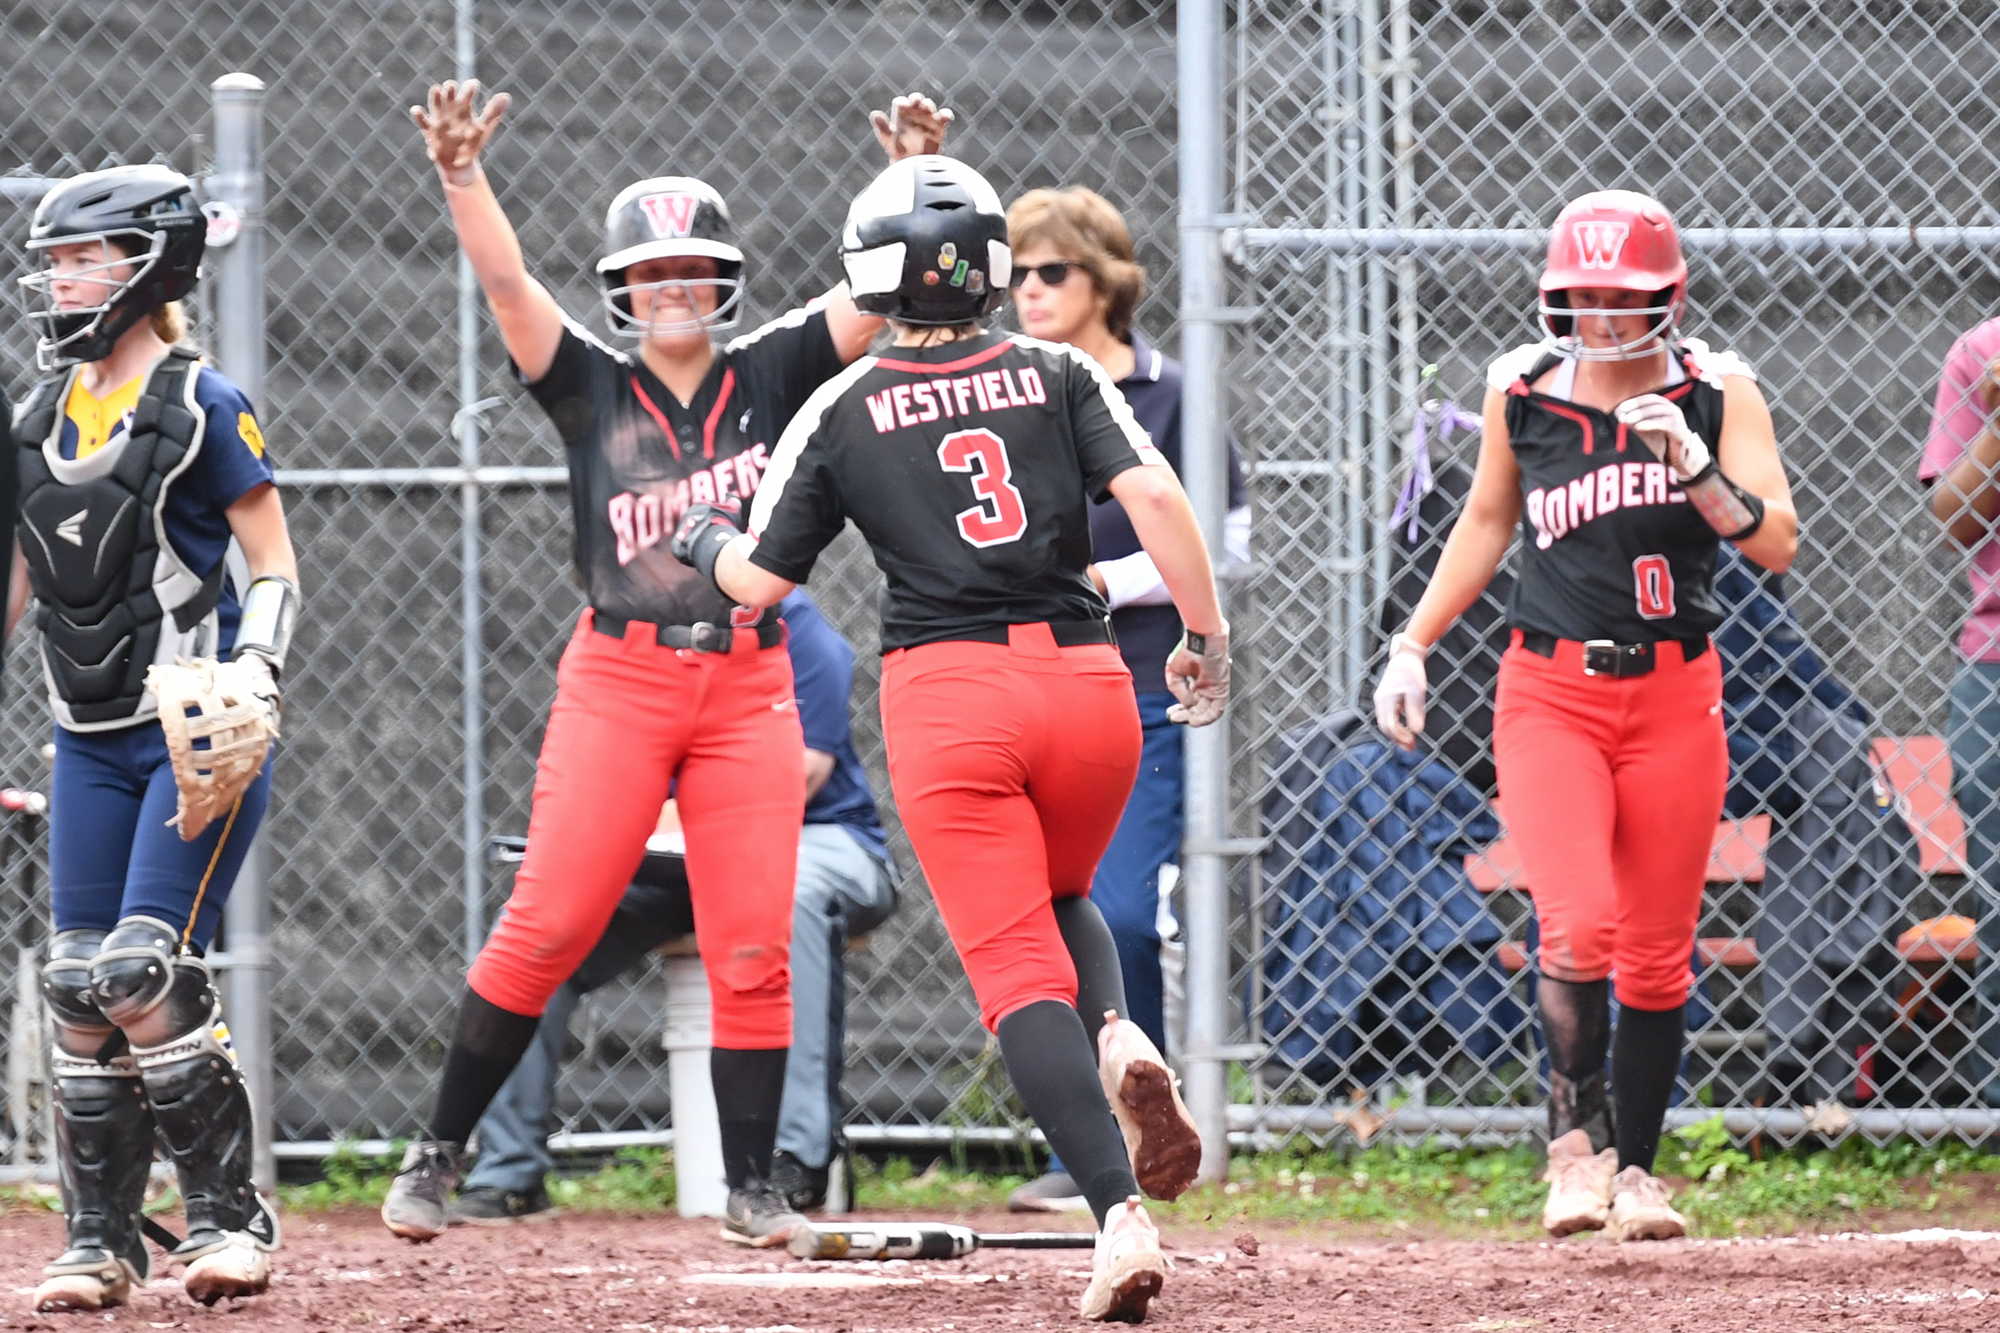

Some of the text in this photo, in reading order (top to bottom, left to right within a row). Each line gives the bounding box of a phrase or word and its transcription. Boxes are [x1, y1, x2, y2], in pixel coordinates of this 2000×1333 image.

[639, 192, 700, 239] W
[1573, 221, 1630, 270] W
[865, 366, 1047, 433] WESTFIELD
[937, 427, 1028, 548] 3
[1632, 553, 1676, 620] 0
